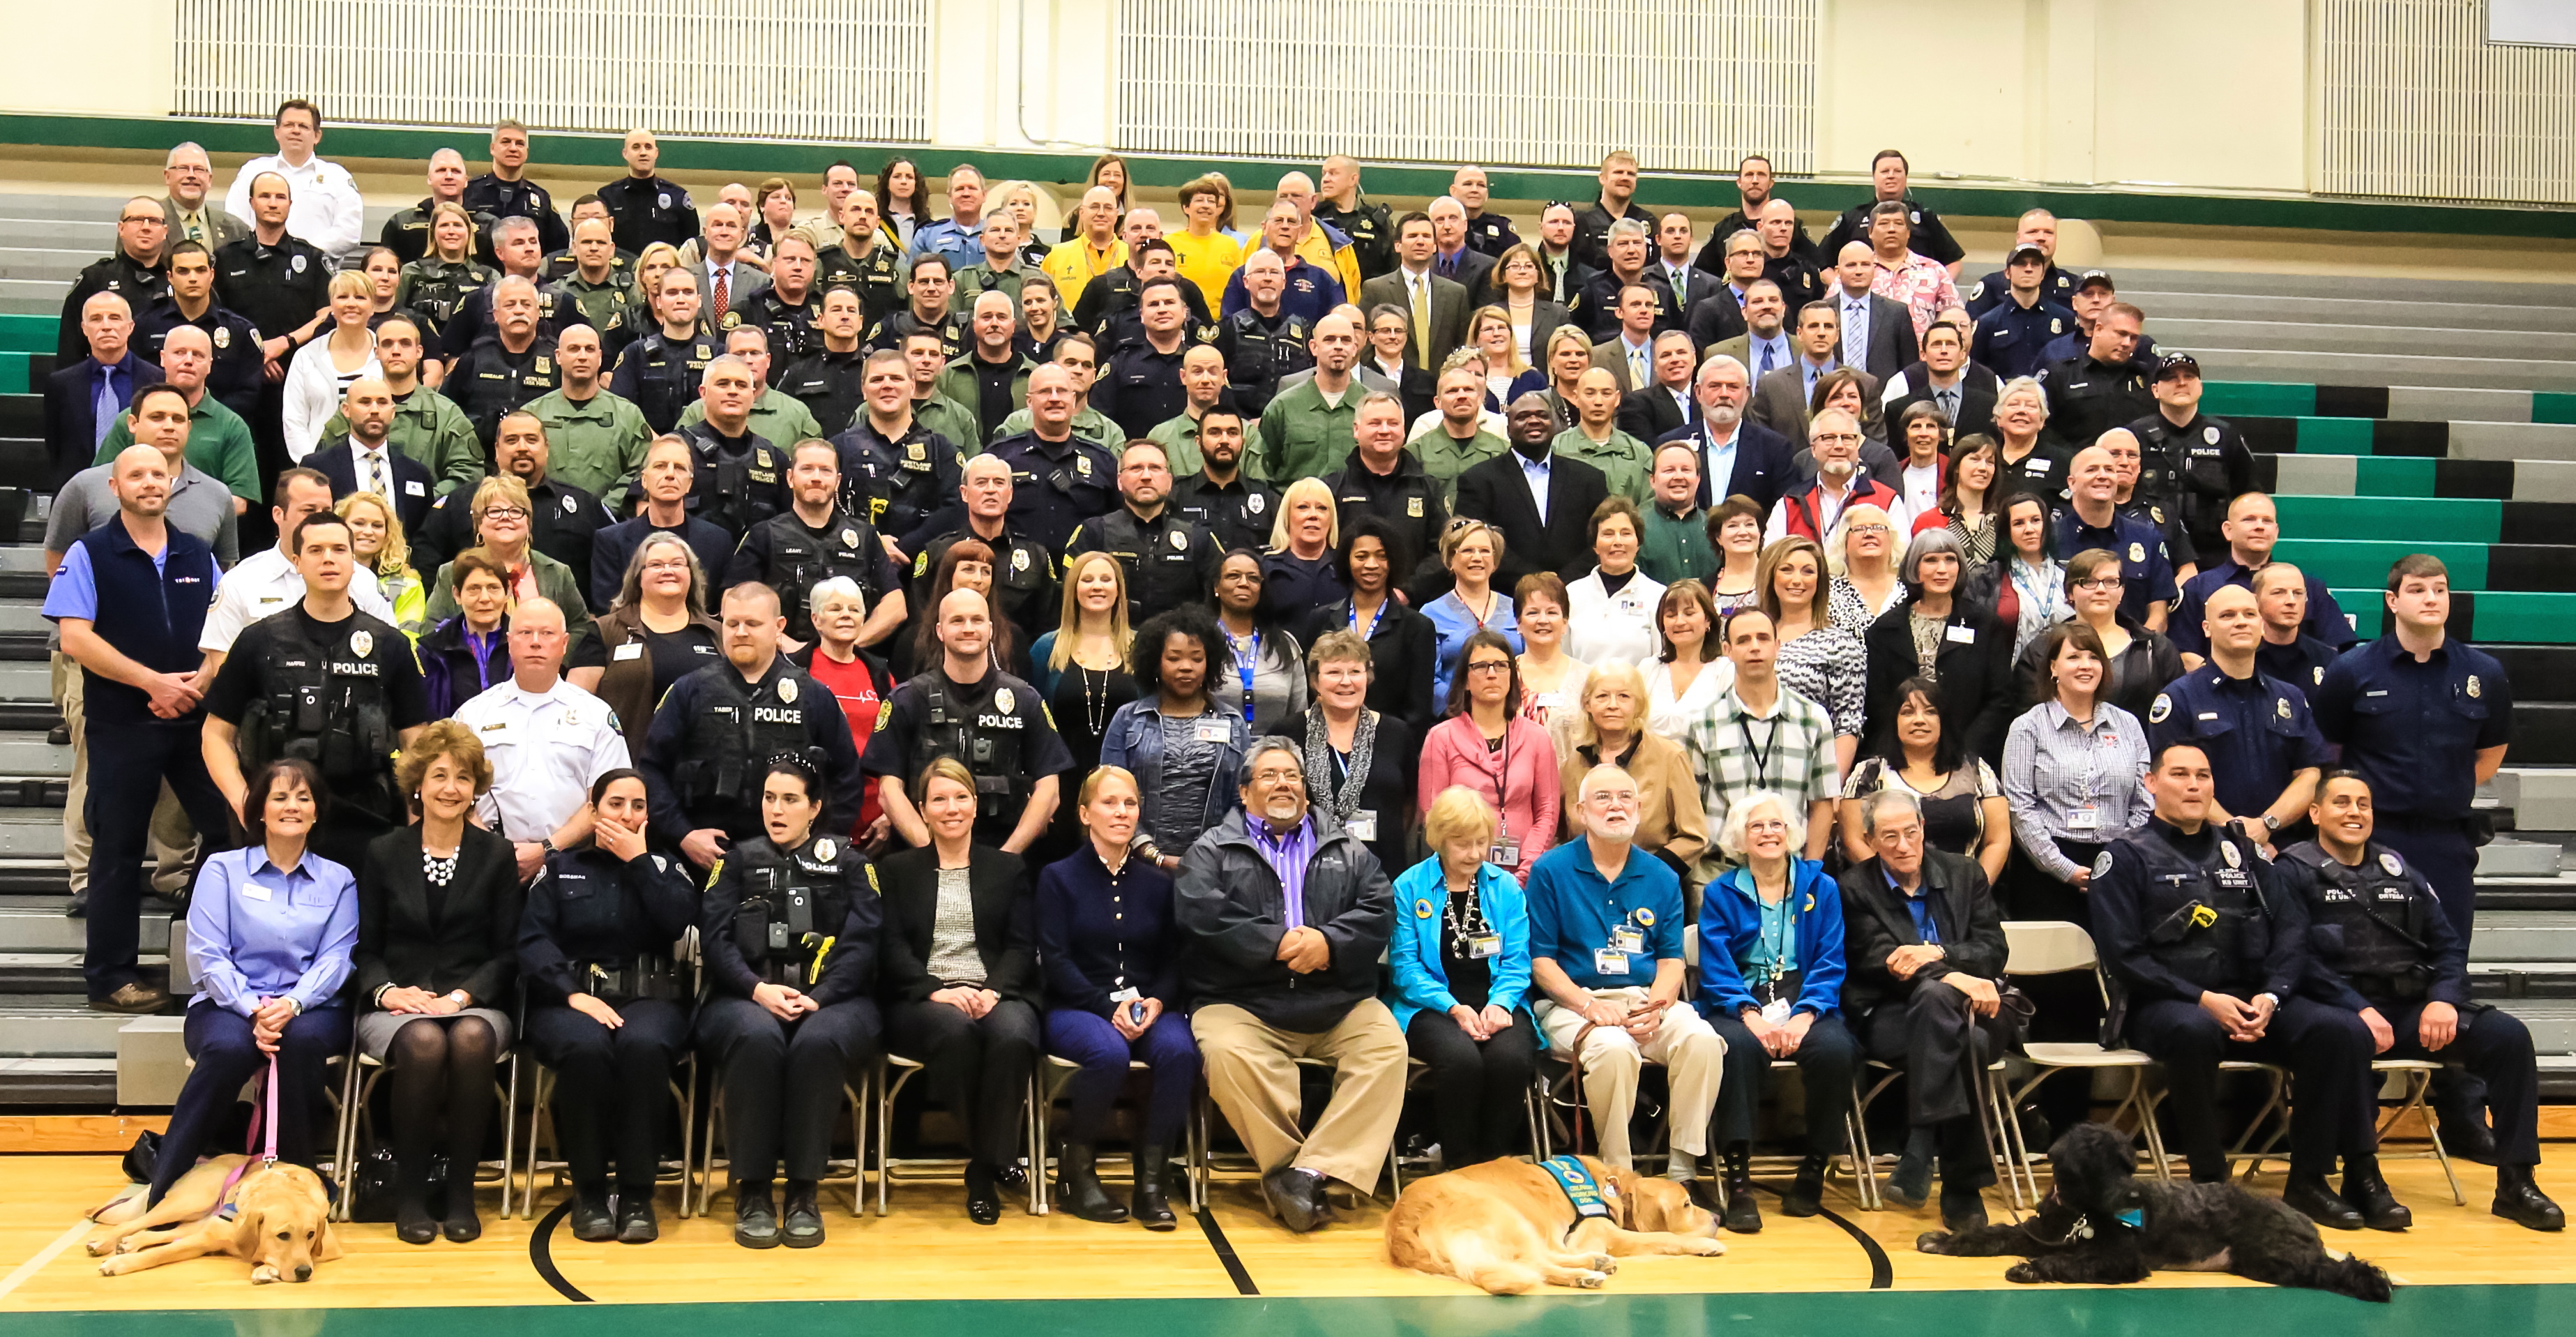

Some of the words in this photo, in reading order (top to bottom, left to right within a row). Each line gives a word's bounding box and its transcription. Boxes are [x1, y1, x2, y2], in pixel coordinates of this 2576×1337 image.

[332, 663, 379, 676] POLICE
[755, 707, 801, 724] POLICE
[978, 714, 1023, 729] POLICE
